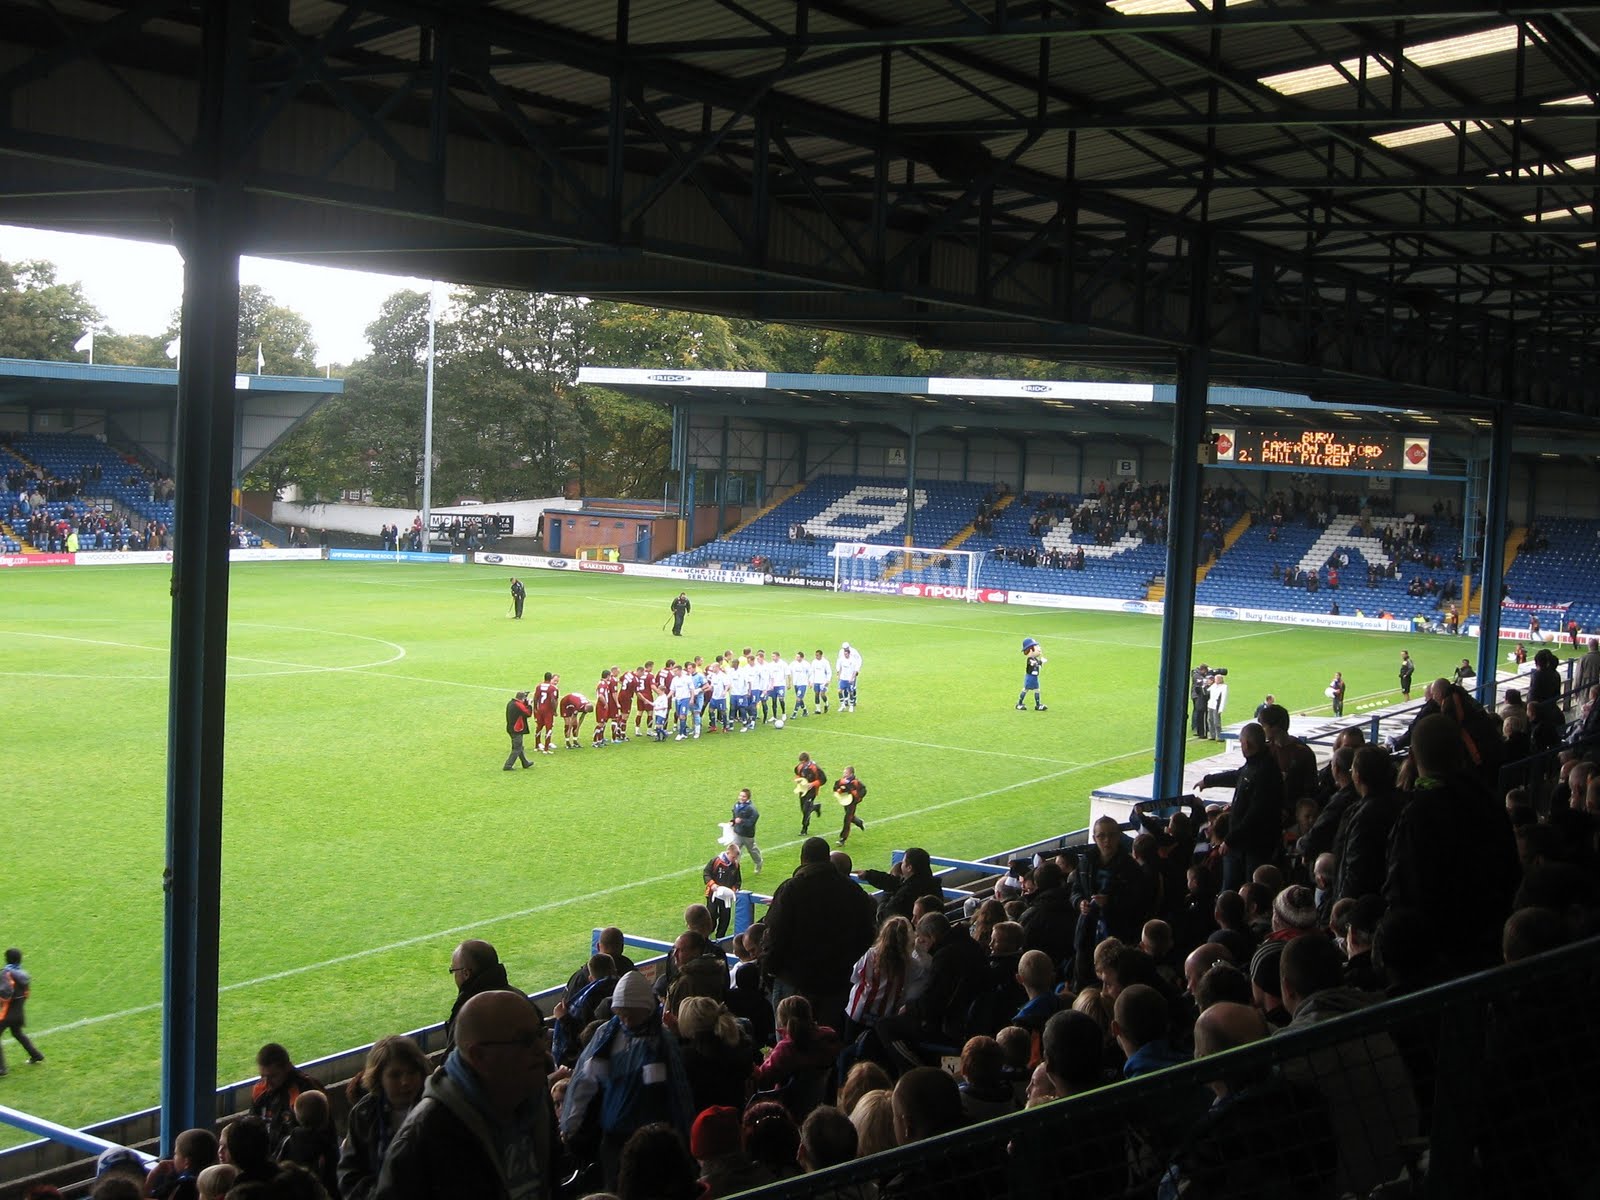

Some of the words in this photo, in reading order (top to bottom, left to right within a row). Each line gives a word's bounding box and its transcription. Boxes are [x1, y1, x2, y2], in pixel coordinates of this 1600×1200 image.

[1262, 440, 1319, 455] CAMERON
[1325, 443, 1383, 458] BELFORD
[1262, 450, 1294, 464] PHIL
[1301, 453, 1350, 467] PICKEN
[1121, 461, 1132, 472] B
[487, 554, 500, 563] Ford
[551, 559, 565, 568] Ford
[687, 573, 725, 582] SERVICES
[730, 571, 762, 579] SAFETY
[774, 576, 805, 585] VILLAGE
[806, 579, 824, 587] Hotel
[925, 586, 983, 600] npower
[1245, 611, 1263, 622] Bury
[1264, 613, 1298, 623] fantastic
[1390, 622, 1409, 631] Bury
[541, 691, 548, 704] 7
